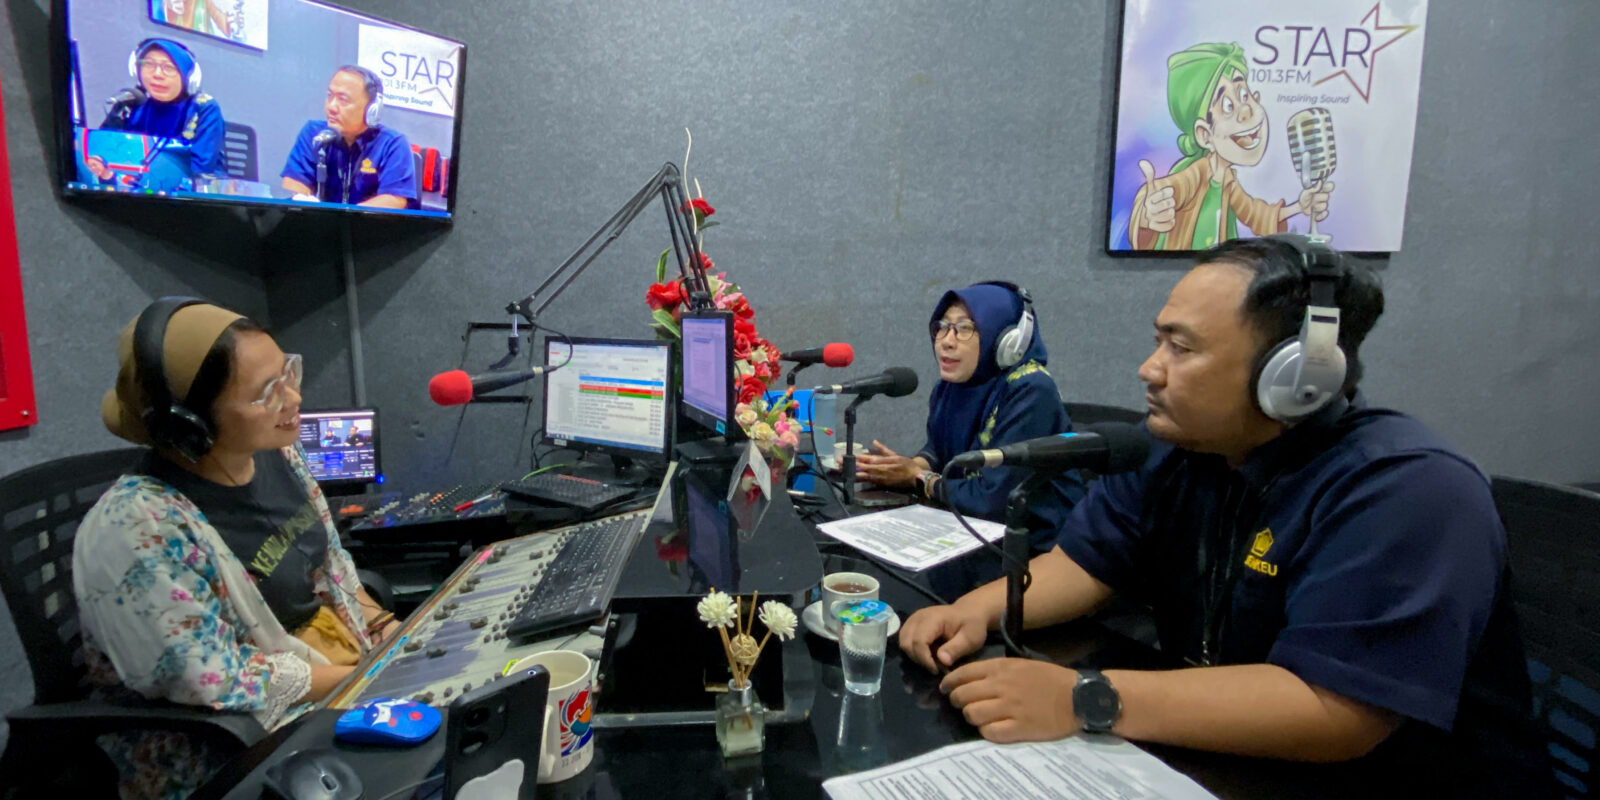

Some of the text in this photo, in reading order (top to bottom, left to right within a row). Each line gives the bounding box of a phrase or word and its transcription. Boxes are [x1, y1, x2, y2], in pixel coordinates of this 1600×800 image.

[1252, 25, 1371, 68] STAR
[381, 51, 454, 88] STAR
[1250, 69, 1312, 84] 101.3FM
[411, 97, 433, 106] Sound
[1276, 93, 1350, 105] Inspiring Sound
